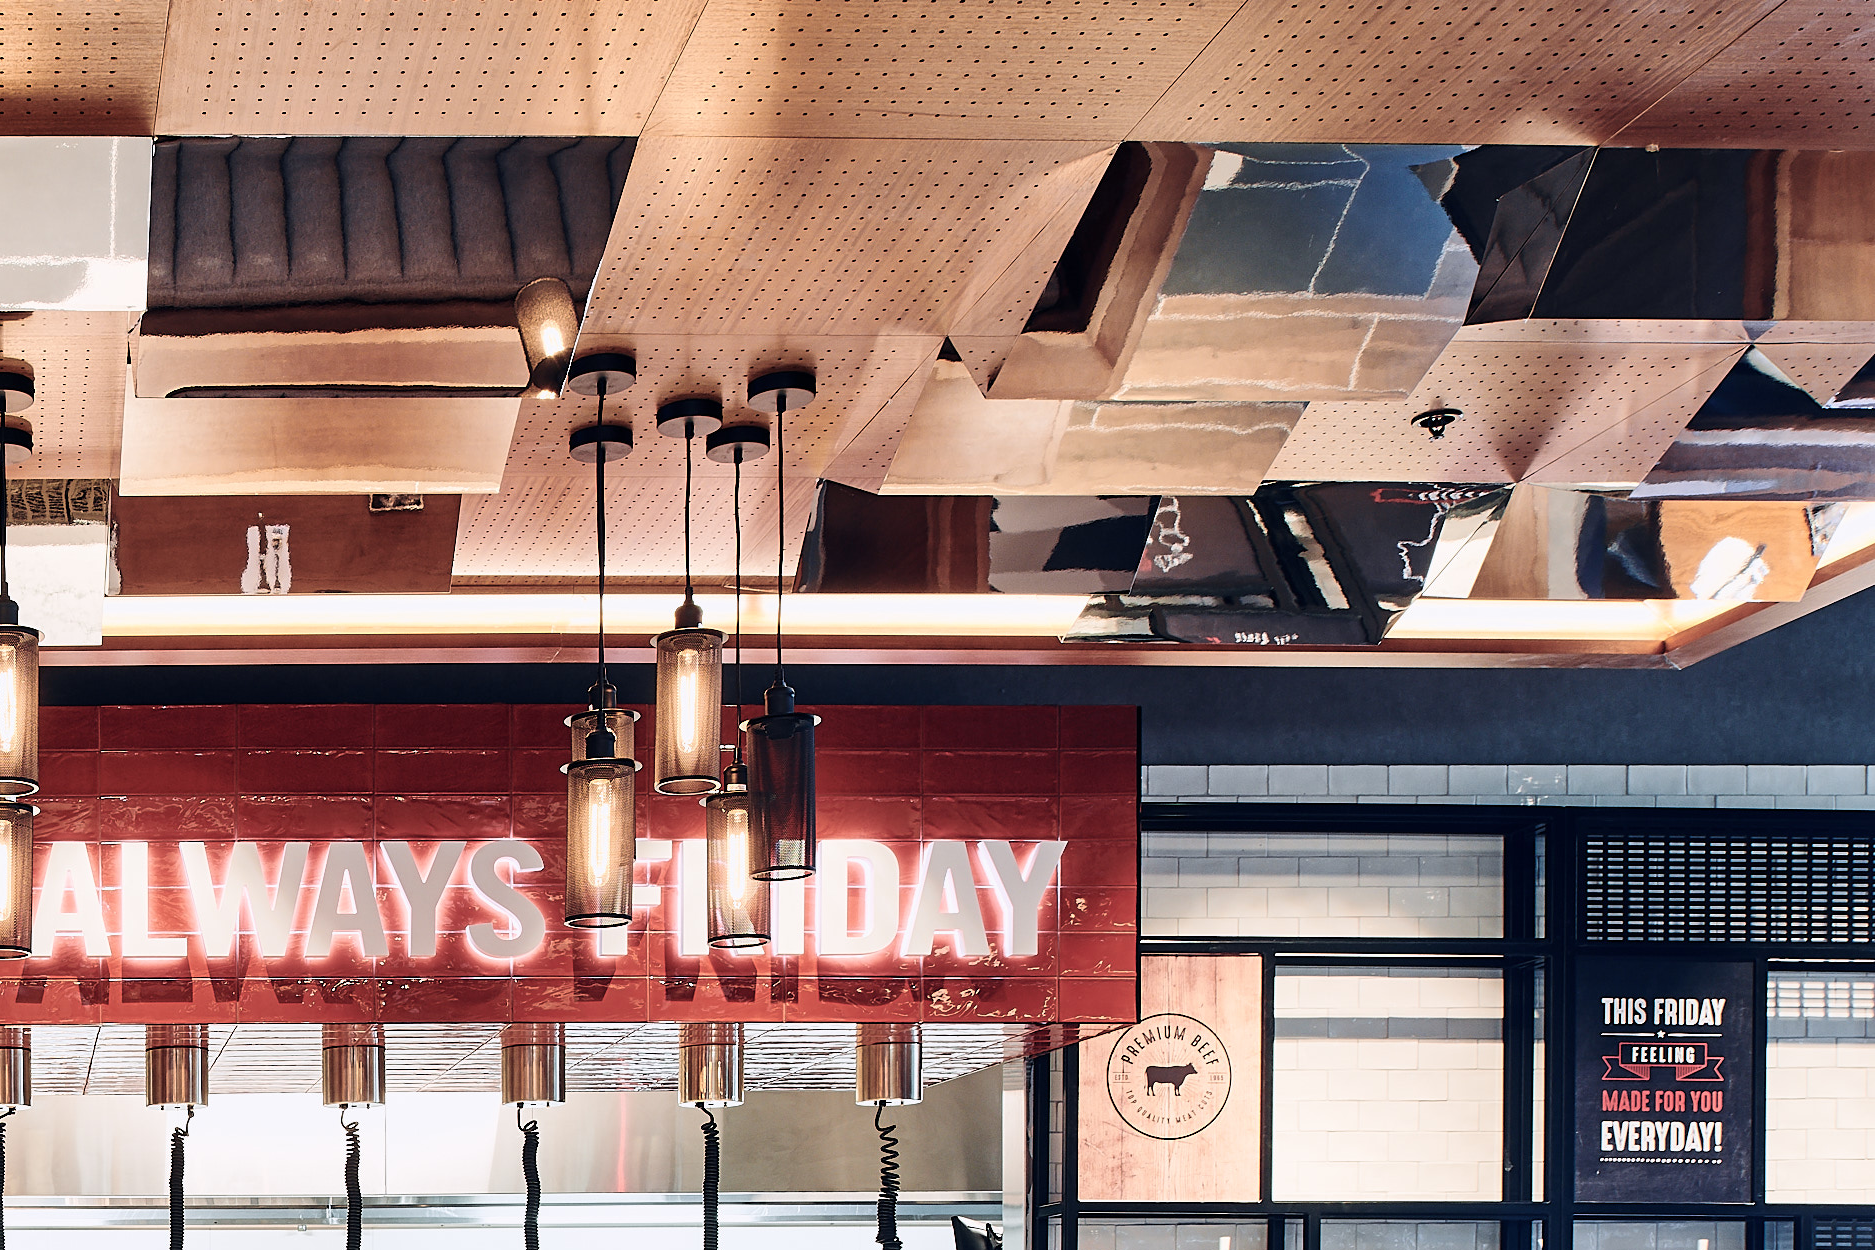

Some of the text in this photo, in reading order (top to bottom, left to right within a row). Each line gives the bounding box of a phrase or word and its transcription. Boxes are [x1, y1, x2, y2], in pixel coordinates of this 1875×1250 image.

[33, 841, 546, 958] ALWAYS
[1602, 998, 1726, 1025] THIS FRIDAY
[1121, 1025, 1219, 1065] PREMIUM BEEF
[1632, 1047, 1695, 1064] FEELING
[1602, 1090, 1723, 1112] MADE FOR YOU
[1137, 1106, 1170, 1124] QUALITY
[1176, 1110, 1196, 1123] MEAT
[1601, 1121, 1723, 1152] EVERYDAY!
